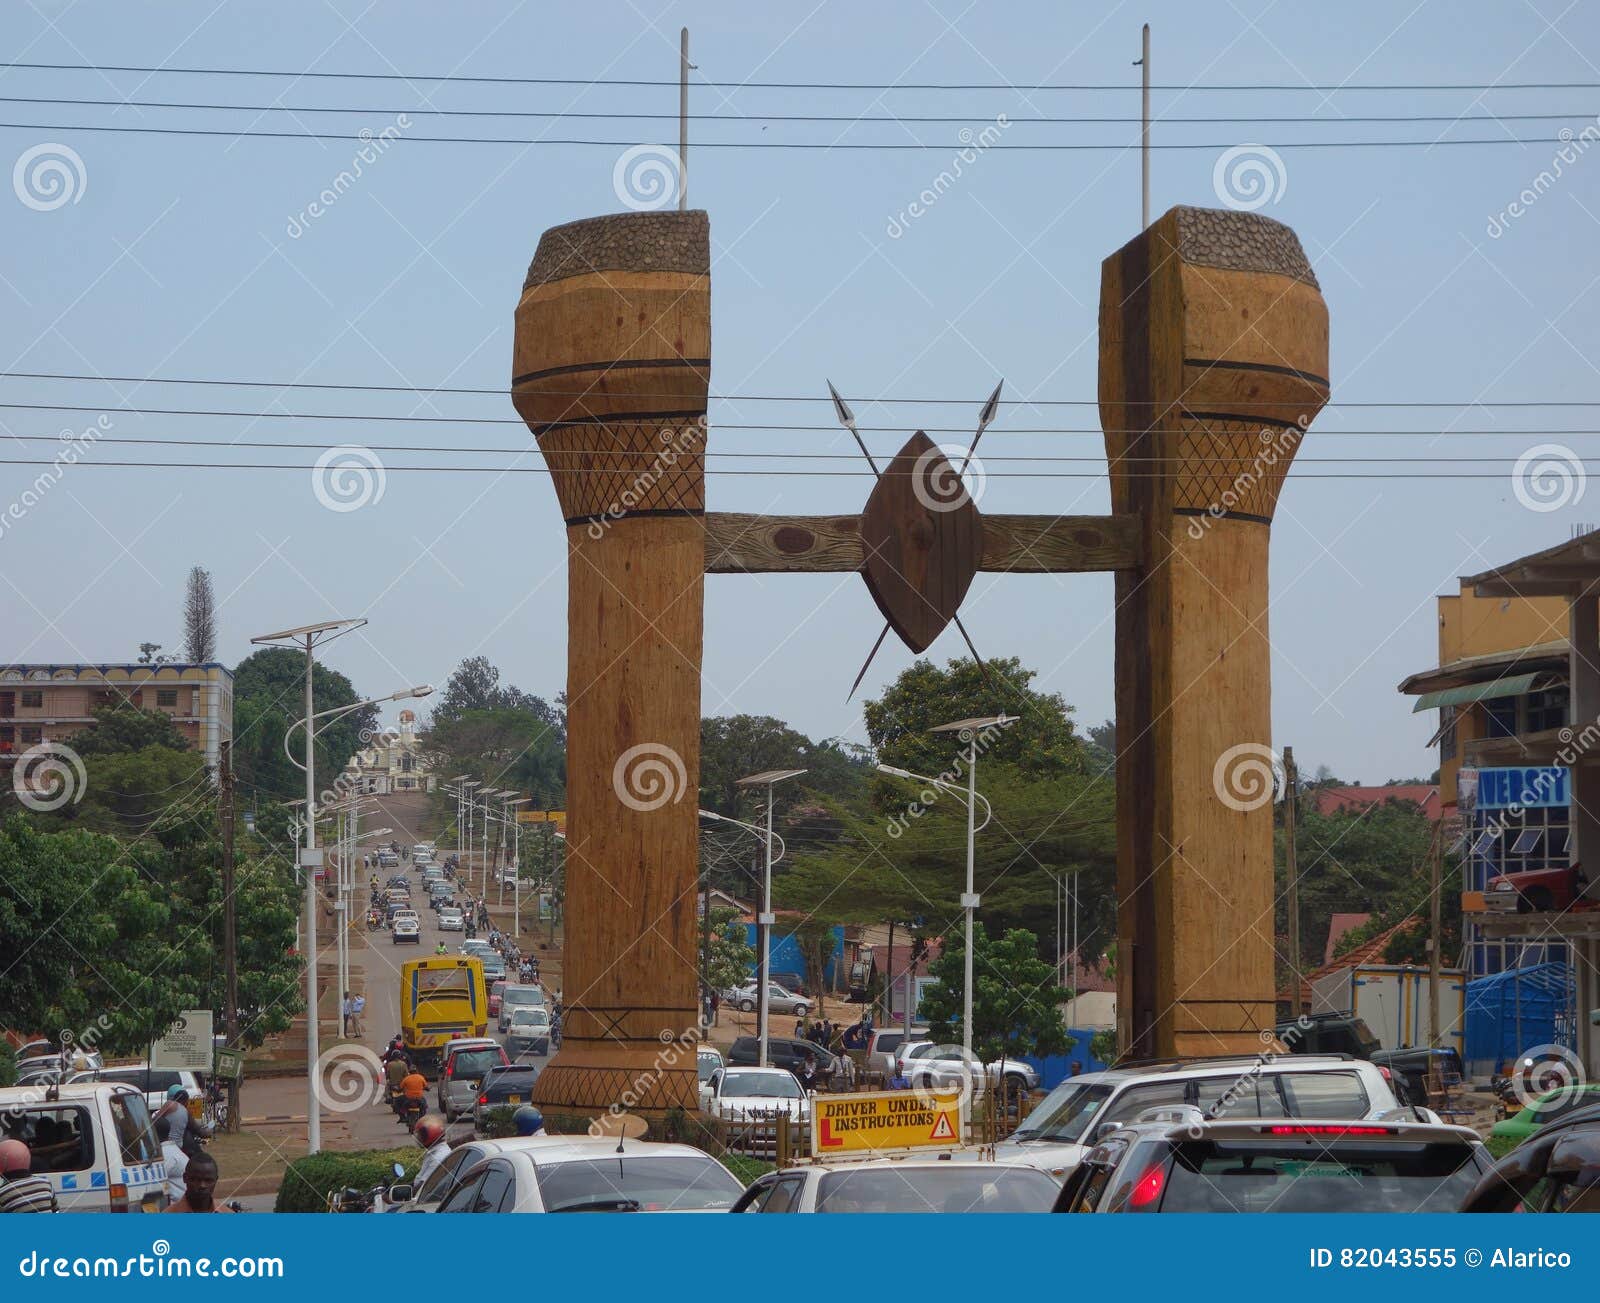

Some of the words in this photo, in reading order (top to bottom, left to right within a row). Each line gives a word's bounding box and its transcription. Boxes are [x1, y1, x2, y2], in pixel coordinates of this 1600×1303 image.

[825, 1100, 877, 1117] DRIVER
[888, 1098, 938, 1113] UNDER
[834, 1112, 934, 1132] INSTRUCTIONS
[820, 1118, 843, 1147] L
